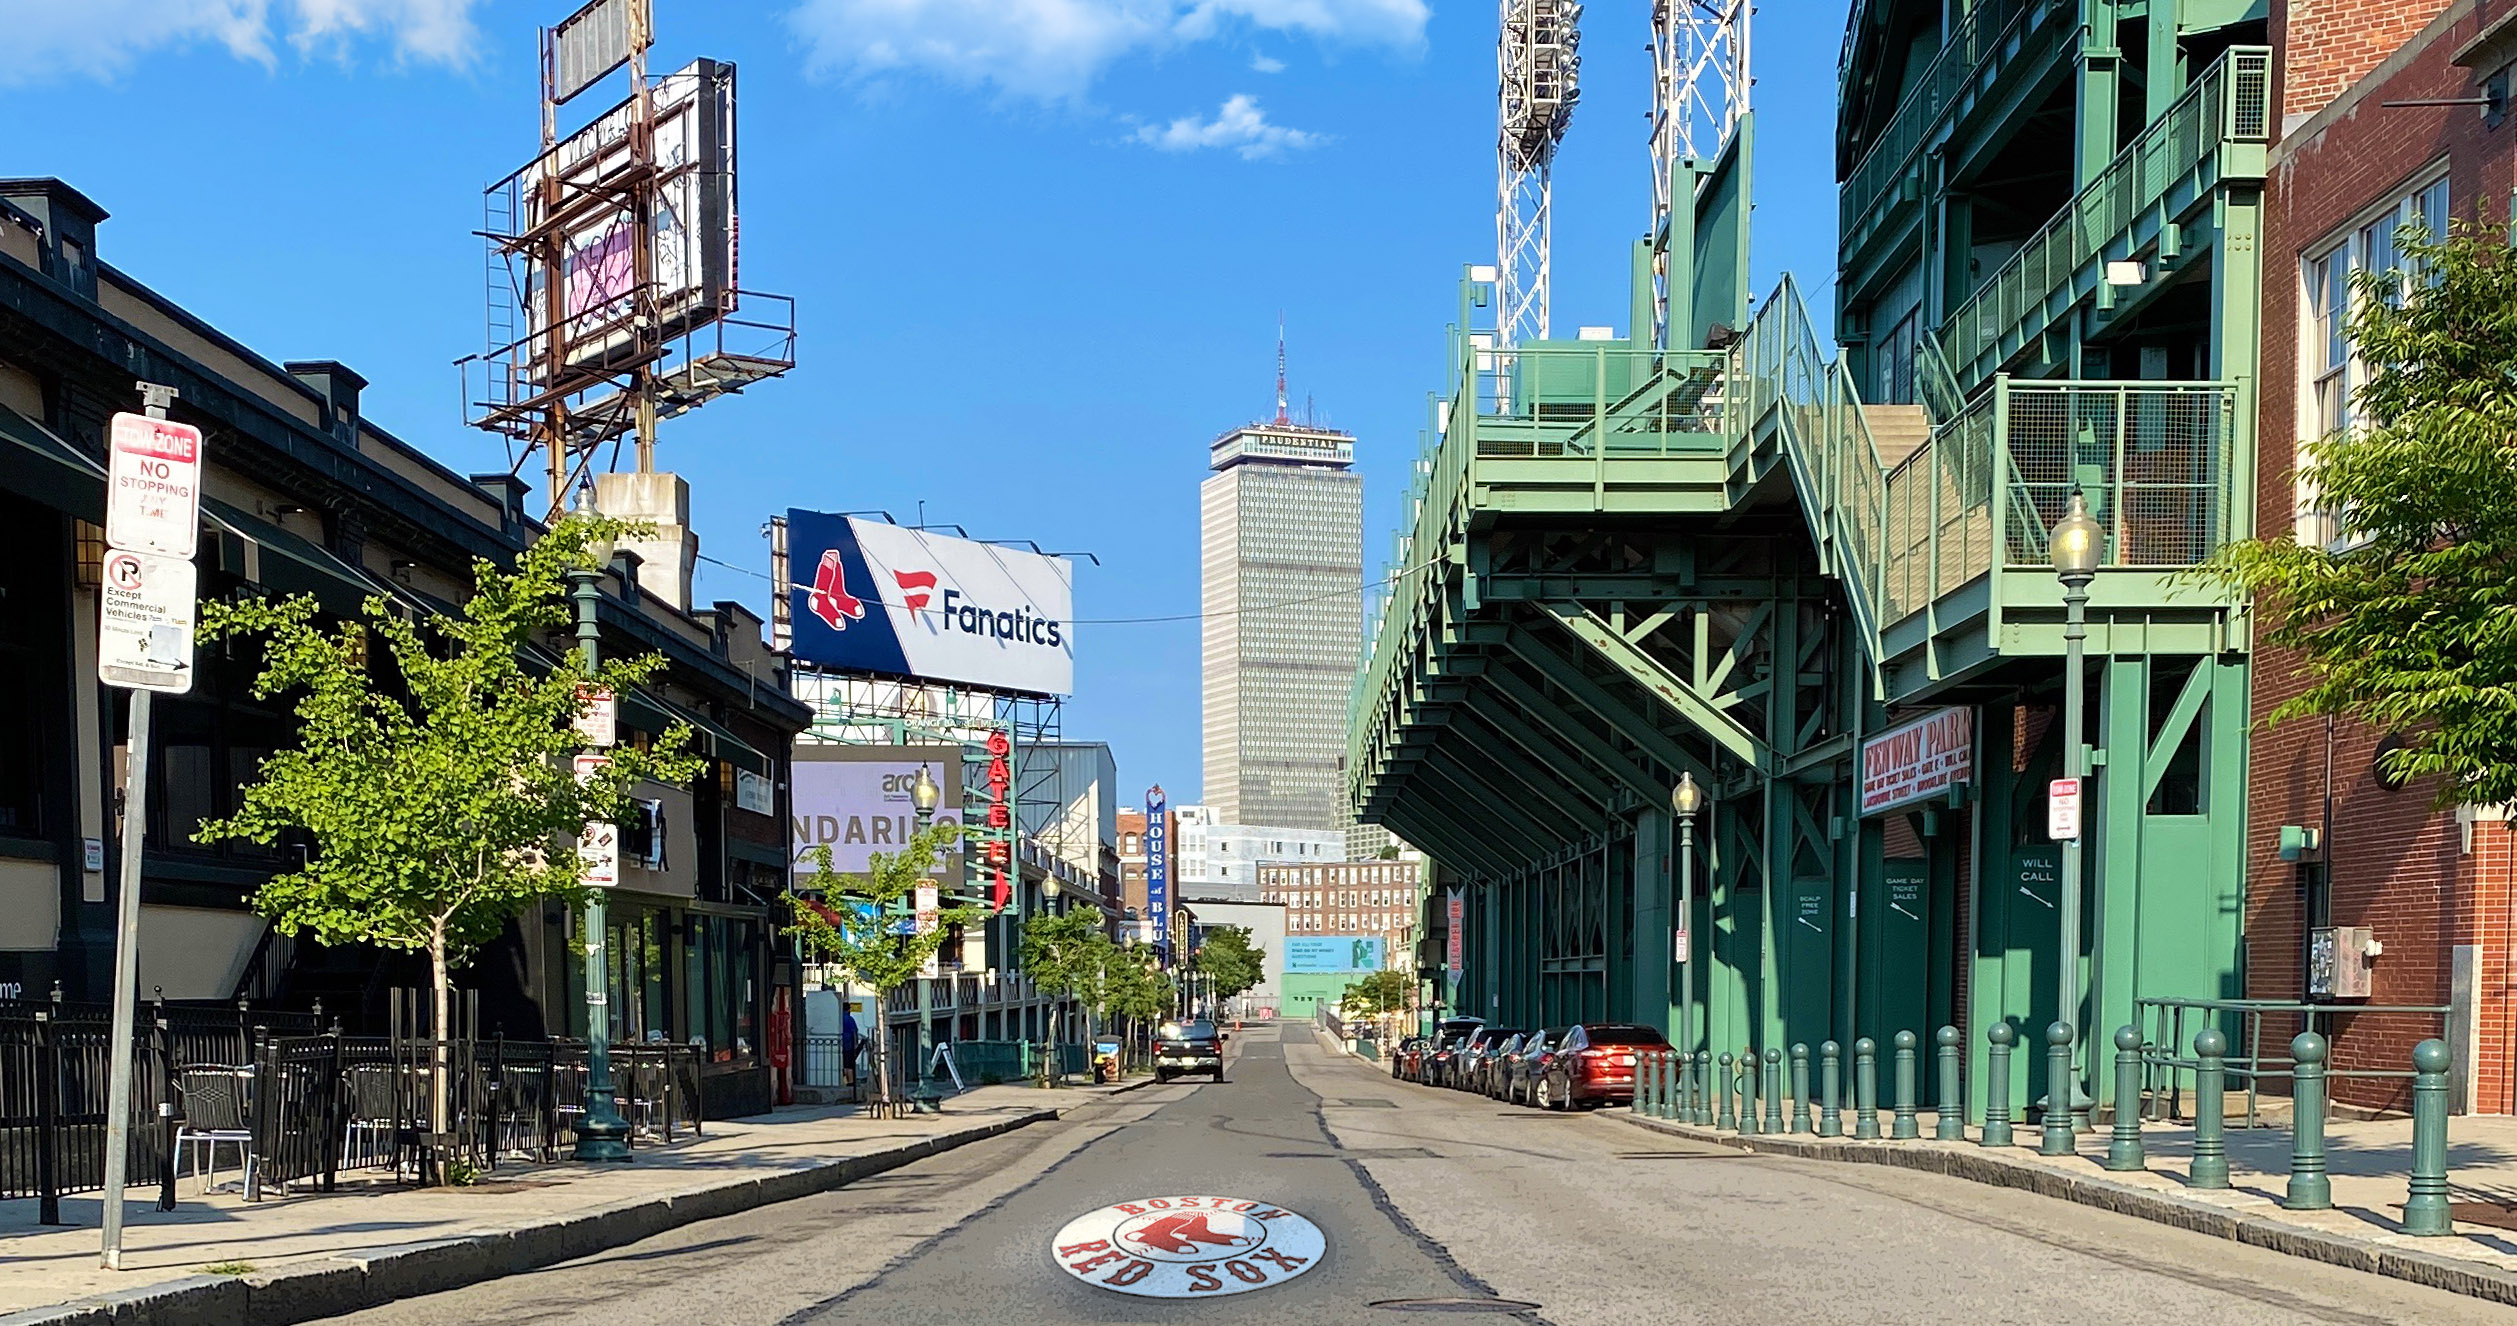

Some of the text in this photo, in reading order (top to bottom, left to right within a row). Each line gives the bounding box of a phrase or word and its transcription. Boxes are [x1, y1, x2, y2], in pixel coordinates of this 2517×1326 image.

[154, 433, 193, 458] ZONE
[1261, 435, 1335, 448] PRUDENTIAL
[140, 460, 170, 479] NO
[120, 476, 189, 498] STOPPING
[139, 505, 165, 518] TME
[107, 586, 142, 600] Except
[105, 607, 148, 621] Vehicles
[106, 597, 167, 614] Commercial
[943, 588, 1061, 648] Fanatics
[982, 719, 1009, 728] MEDIA
[1864, 708, 1972, 780] FENWAY PARK
[882, 770, 924, 793] arc
[987, 731, 1009, 828] GATE
[791, 814, 958, 845] NDARIO
[989, 841, 1009, 864] E
[1150, 813, 1164, 880] HOUSE
[2022, 859, 2053, 868] WILL
[2020, 872, 2054, 881] CALL
[1152, 901, 1164, 941] BLU
[1112, 1196, 1292, 1221] BOSTON
[1058, 1238, 1309, 1293] RED SOX
